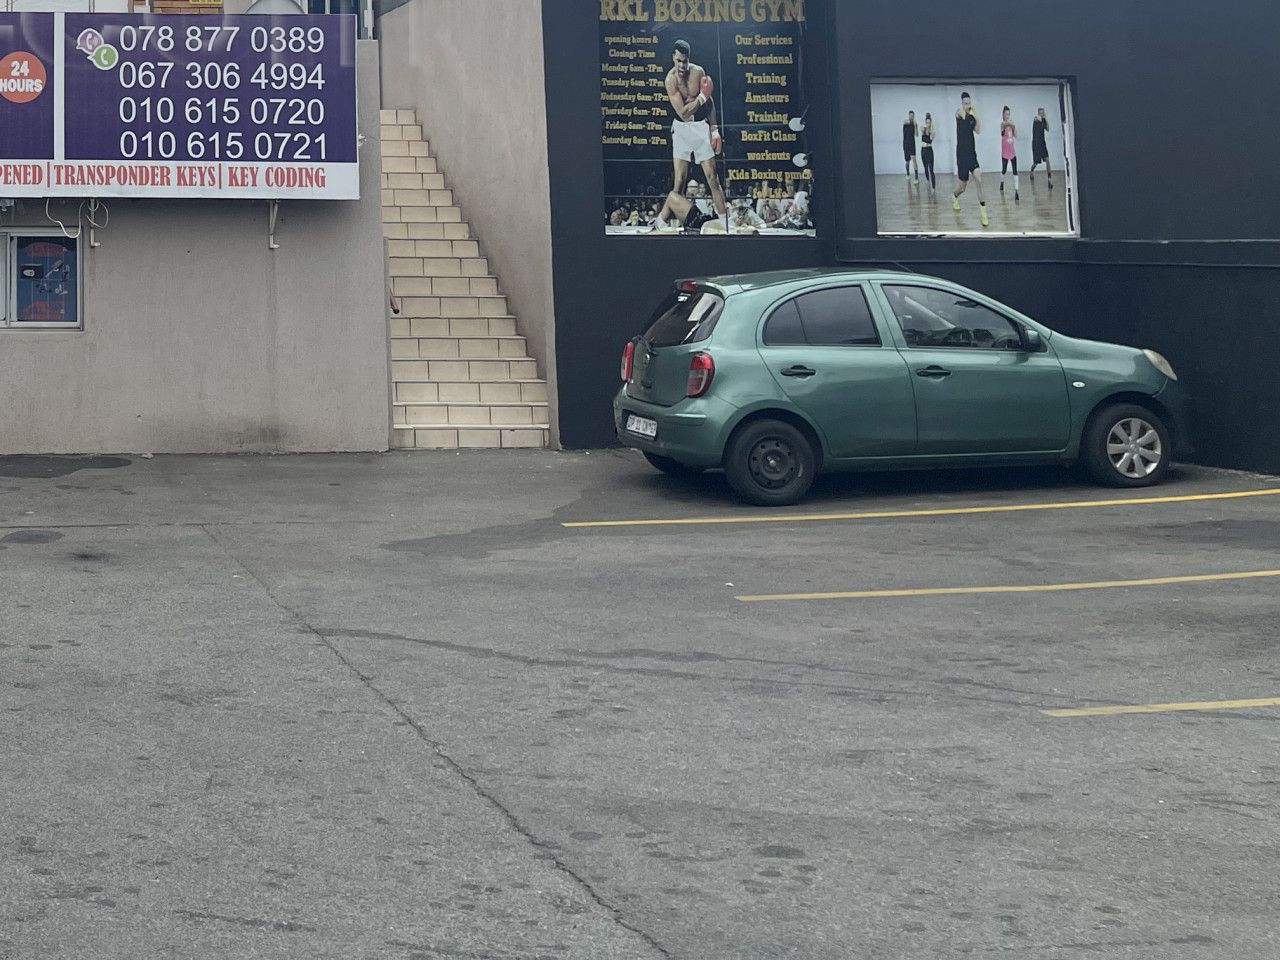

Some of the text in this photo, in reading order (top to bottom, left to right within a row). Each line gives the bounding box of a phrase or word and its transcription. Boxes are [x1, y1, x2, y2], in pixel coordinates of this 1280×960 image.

[119, 25, 325, 53] 078 877 0389
[631, 35, 653, 44] hours
[734, 34, 793, 46] Our Services
[736, 53, 794, 65] Professional
[10, 60, 30, 77] 24
[601, 63, 628, 74] Monday
[119, 61, 326, 90] 067 306 4994
[745, 72, 787, 87] Training
[601, 78, 629, 88] Tuesday
[745, 91, 790, 103] Amateurs
[119, 96, 325, 125] 010 615 0720
[601, 106, 632, 117] Thursday
[746, 110, 789, 124] Training
[605, 121, 627, 131] Friday
[601, 135, 632, 146] Saturday
[741, 129, 797, 142] BoxFit Class
[119, 131, 327, 160] 010 615 0721
[746, 149, 791, 161] workouts
[53, 165, 171, 187] TRANSPONDER
[176, 166, 216, 187] KEYS
[228, 167, 260, 188] KEY
[265, 167, 326, 189] CODING
[728, 169, 750, 181] Kids
[750, 168, 783, 181] Boxing
